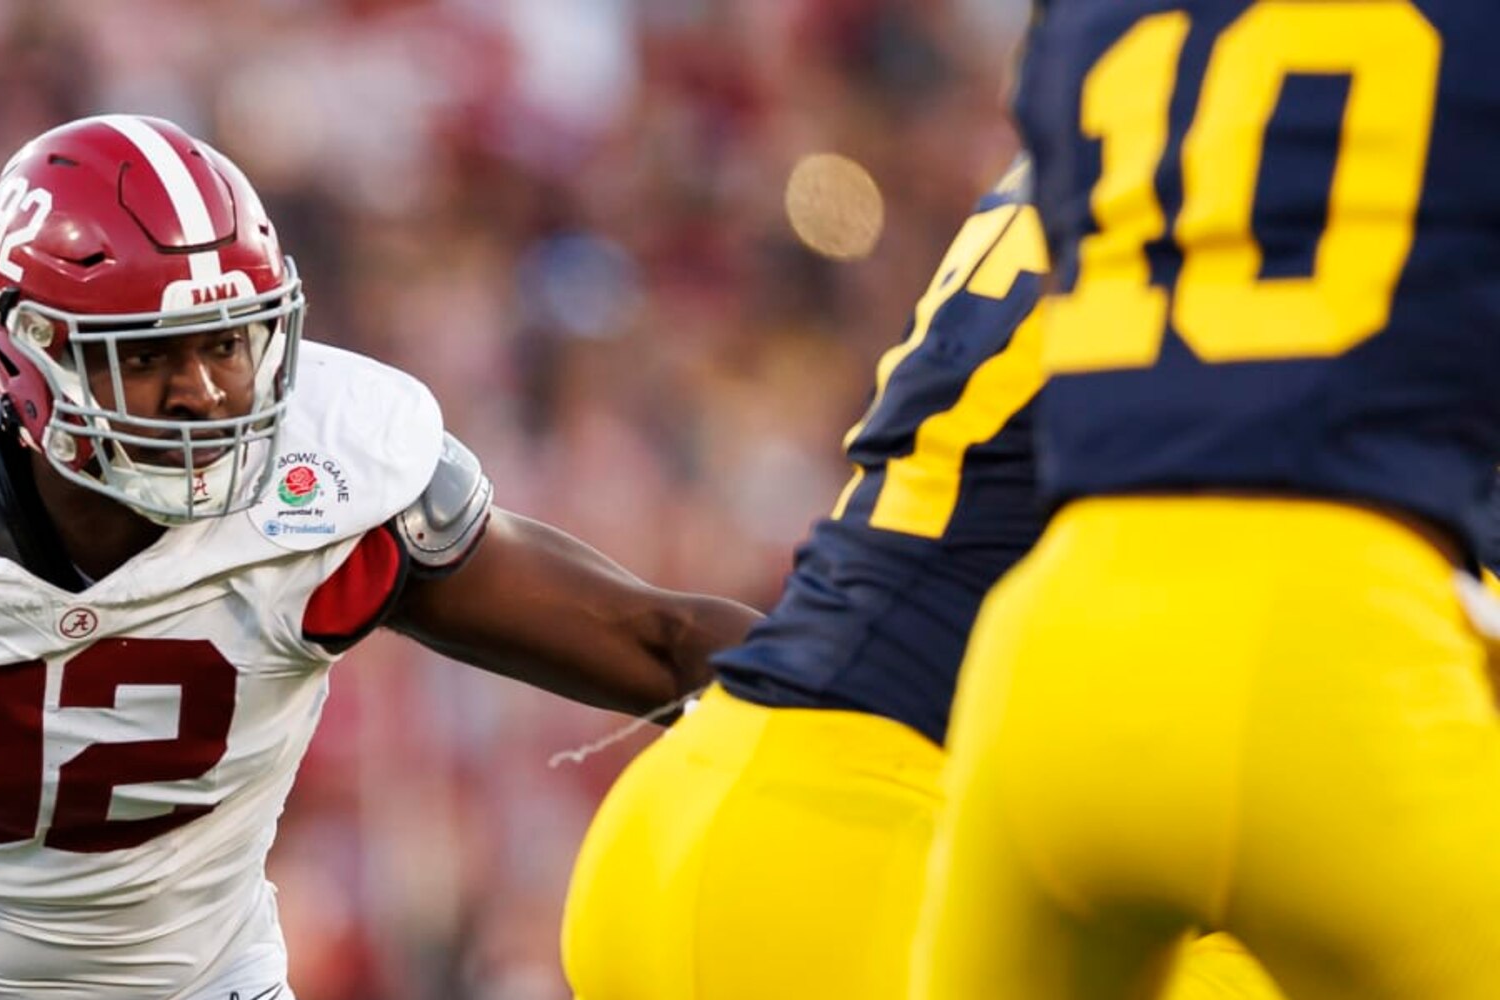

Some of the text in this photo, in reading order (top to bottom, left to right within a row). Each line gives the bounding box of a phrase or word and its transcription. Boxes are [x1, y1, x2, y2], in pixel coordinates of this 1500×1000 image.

[1039, 0, 1443, 374] 10
[191, 282, 239, 306] BAMA
[278, 452, 349, 503] BOWL GAME
